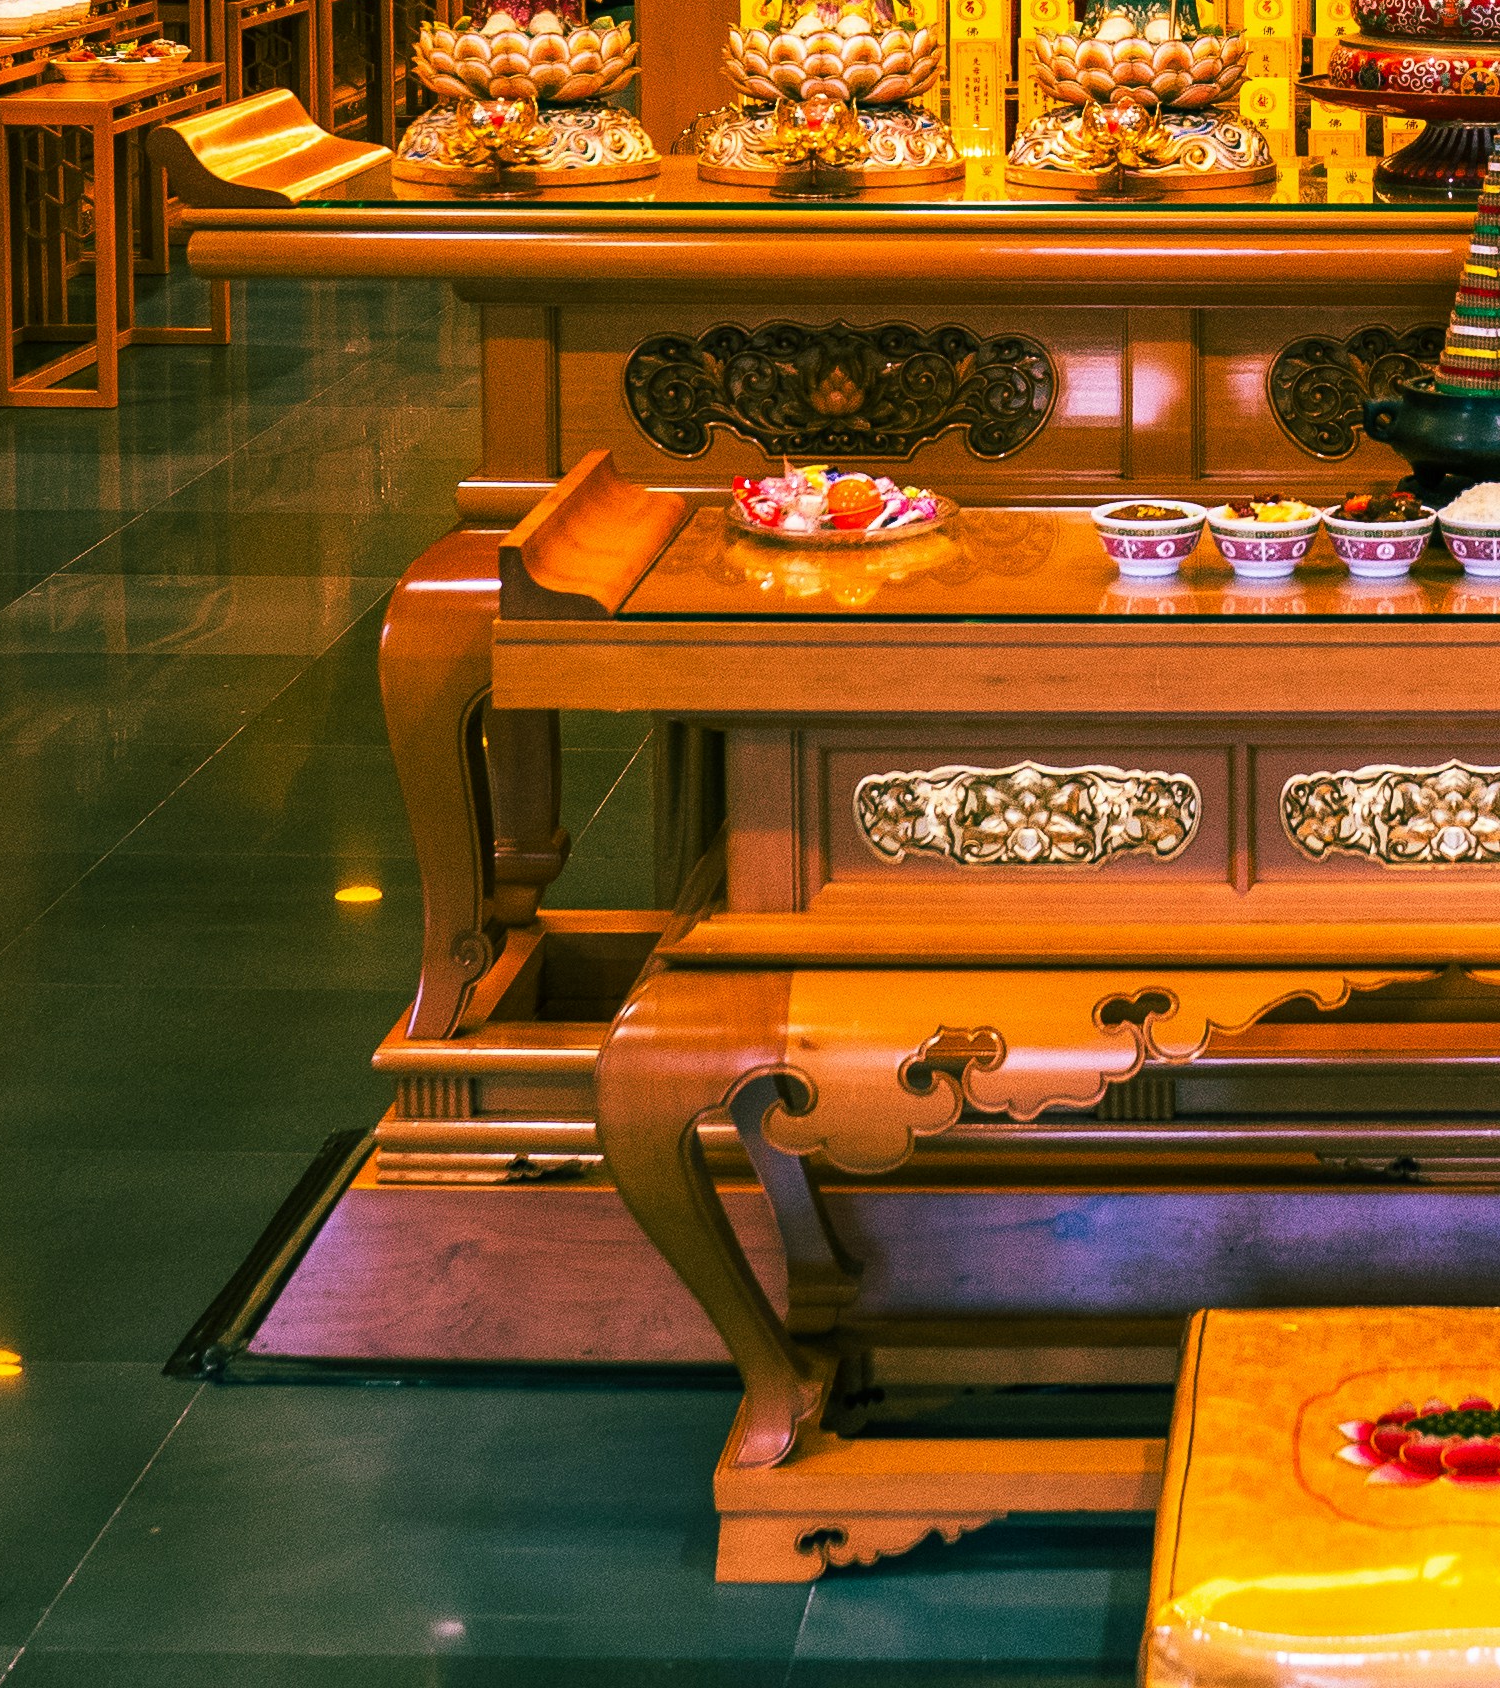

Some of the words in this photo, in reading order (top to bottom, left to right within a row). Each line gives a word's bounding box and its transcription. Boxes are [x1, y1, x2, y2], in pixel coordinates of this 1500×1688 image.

[966, 26, 979, 36] 佛
[1263, 26, 1276, 36] 佛
[1328, 118, 1342, 128] 佛
[1405, 120, 1418, 130] 佛
